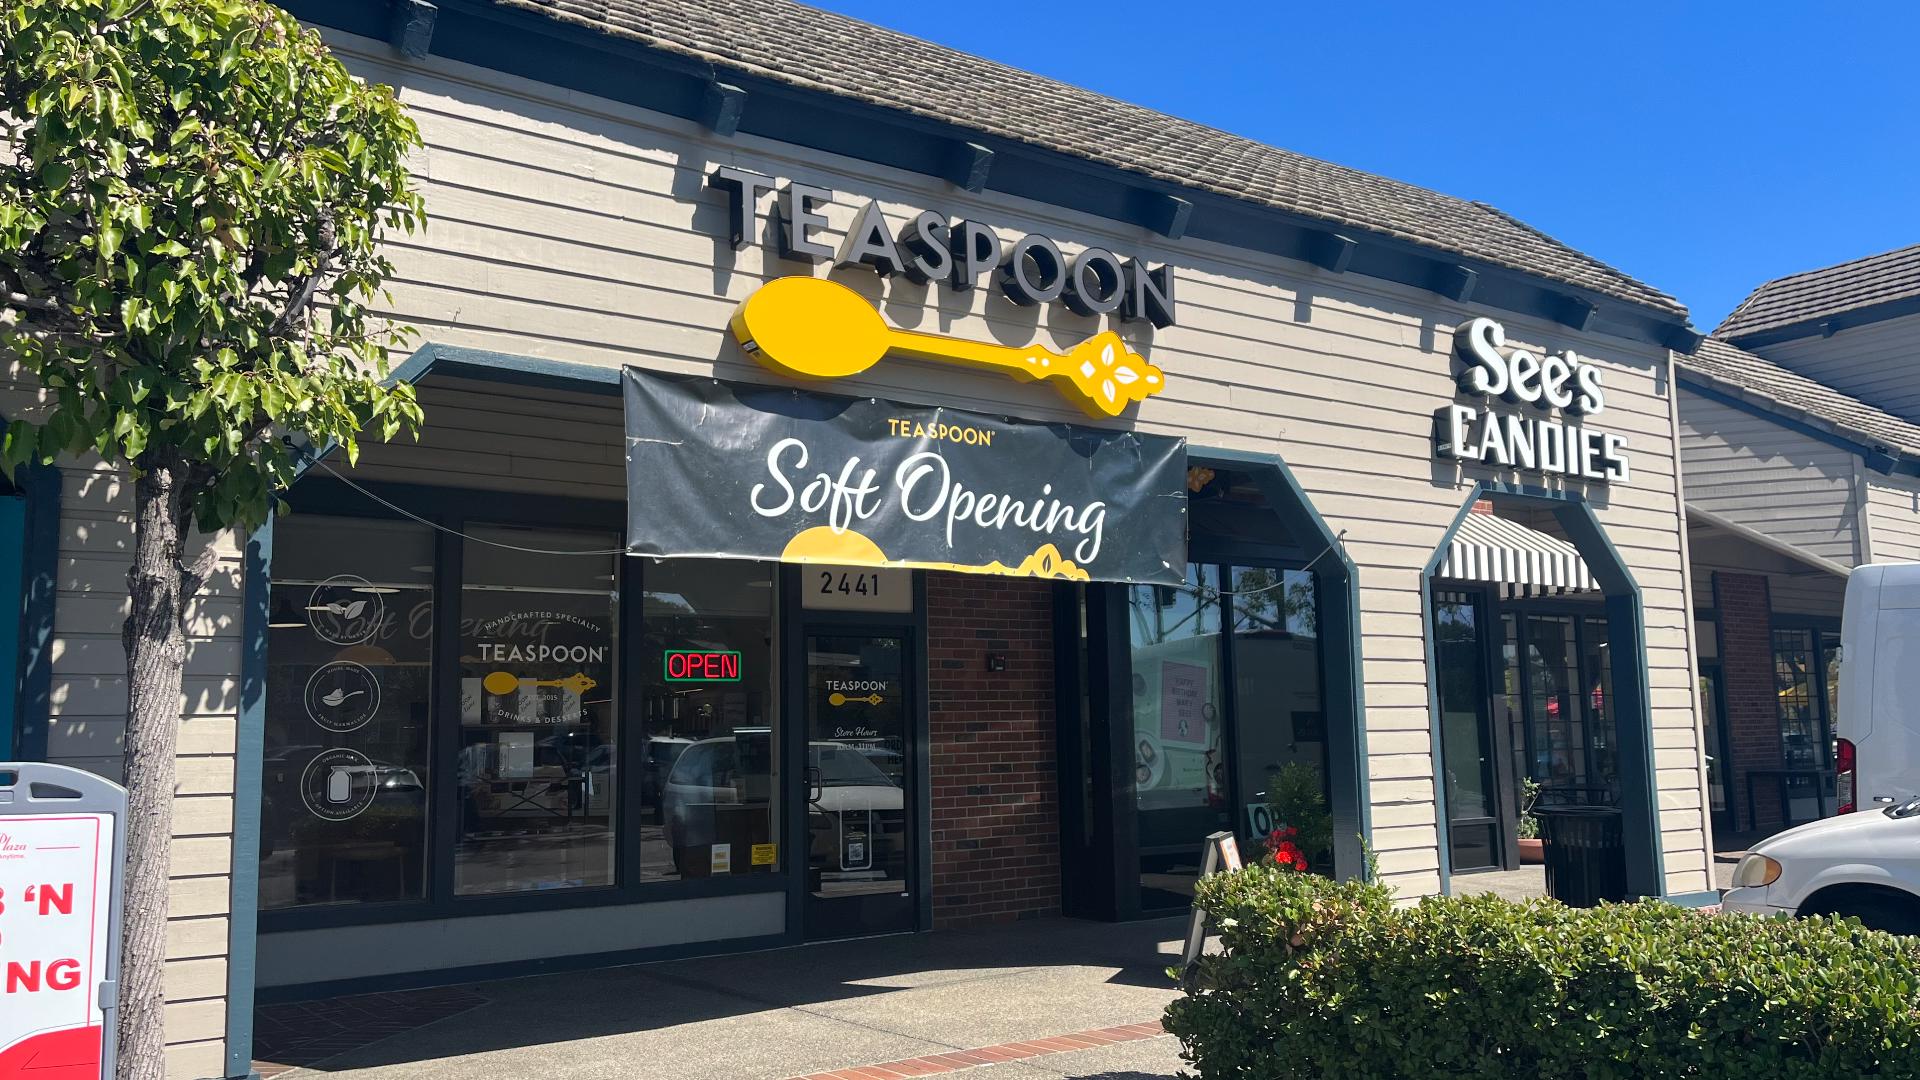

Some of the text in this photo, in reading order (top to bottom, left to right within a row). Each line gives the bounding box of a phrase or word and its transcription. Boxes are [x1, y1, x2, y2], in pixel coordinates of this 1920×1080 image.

[712, 166, 1176, 330] TEASPOON
[1462, 316, 1605, 415] See's
[887, 418, 992, 447] TEASPOON
[1446, 404, 1631, 482] CANDIES
[750, 437, 1107, 564] Soft Opening
[820, 571, 880, 596] 2441
[484, 611, 601, 633] HANDCRAFTED SPECIALTY
[477, 643, 604, 663] TEASPOON
[668, 653, 738, 678] OPEN
[826, 680, 887, 691] TEASPOON
[497, 709, 532, 723] DRINKS
[544, 708, 588, 724] DESSERTS
[834, 726, 879, 738] Store Hours
[322, 754, 345, 763] ORGANIC
